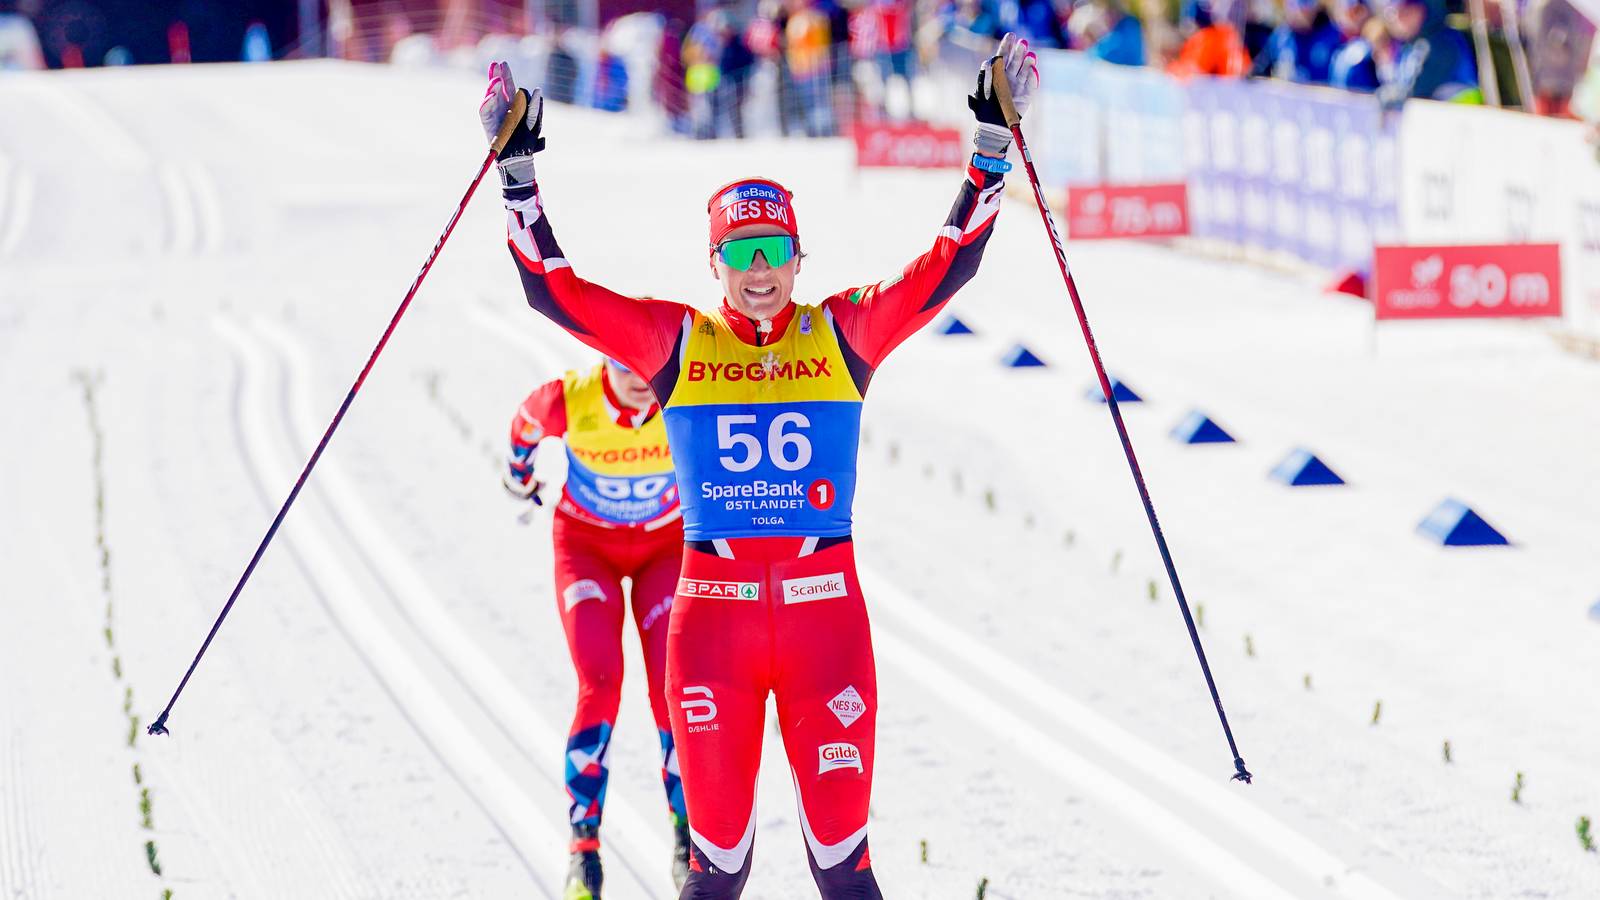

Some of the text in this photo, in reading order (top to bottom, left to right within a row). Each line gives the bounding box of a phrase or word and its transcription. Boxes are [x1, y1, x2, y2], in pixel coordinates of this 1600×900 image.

[723, 188, 776, 203] areBank
[726, 200, 789, 225] NES SKI
[1449, 263, 1507, 308] 50
[1509, 272, 1550, 307] m
[688, 356, 832, 382] BYGGMAX
[716, 411, 813, 473] 56
[701, 480, 828, 504] SpareBank 1
[725, 499, 805, 511] ØSTLANDET
[751, 516, 785, 525] TOLGA
[687, 583, 737, 596] SPAR
[790, 580, 841, 597] Scandic
[832, 699, 864, 712] NES SKI
[688, 723, 720, 733] DÆHLIE
[822, 746, 858, 760] Gilde
